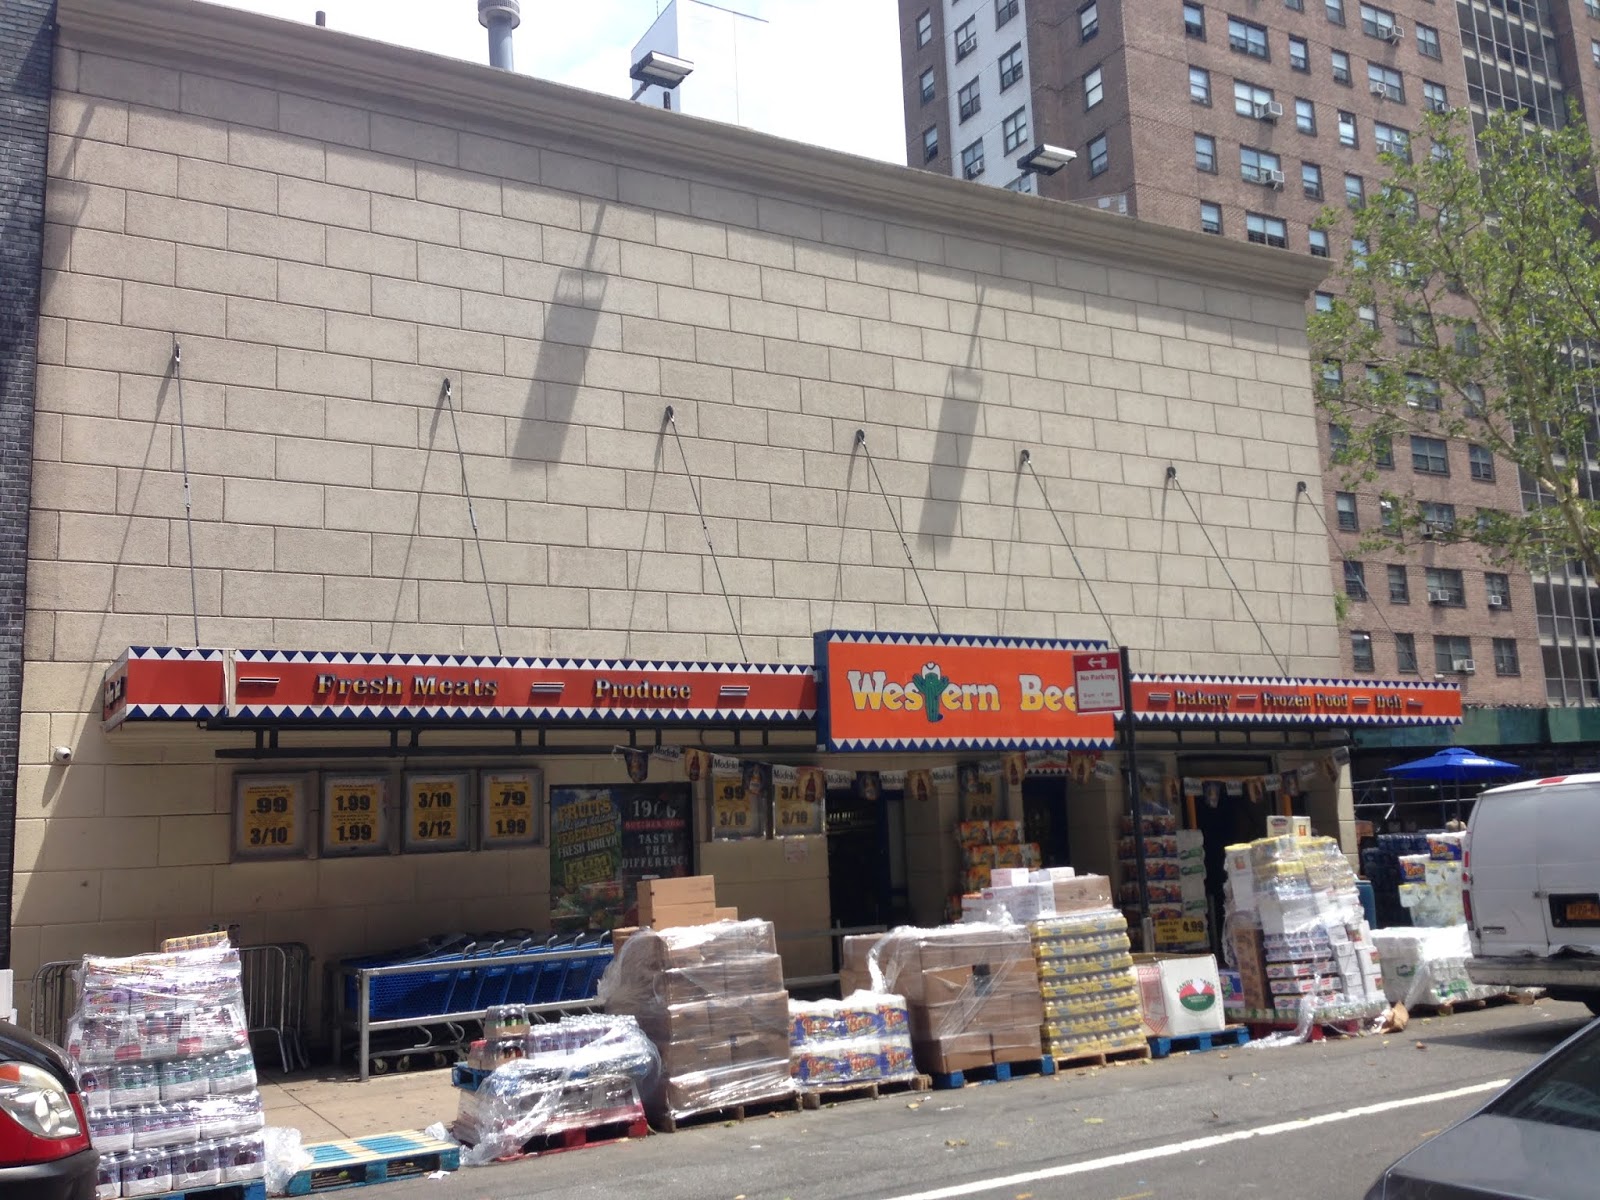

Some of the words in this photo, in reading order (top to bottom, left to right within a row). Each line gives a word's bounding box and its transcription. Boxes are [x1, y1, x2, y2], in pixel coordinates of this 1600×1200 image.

[316, 674, 403, 696] Fresh
[412, 675, 499, 697] Meats
[594, 678, 692, 700] Produce
[847, 664, 1000, 720] Western
[1018, 673, 1077, 712] Bee
[1175, 690, 1232, 709] Bakery
[1262, 691, 1312, 707] Frozen
[1315, 692, 1348, 708] Food
[1375, 694, 1403, 709] Deli
[250, 797, 288, 814] .99
[336, 795, 371, 811] 1.99
[418, 792, 452, 809] 3/10
[558, 799, 611, 822] FRUITS
[250, 827, 288, 845] 3/10
[336, 824, 372, 841] 1.99
[418, 820, 452, 837] 3/12
[638, 832, 674, 845] TASTE
[558, 843, 586, 859] FRESH
[645, 845, 668, 856] THE
